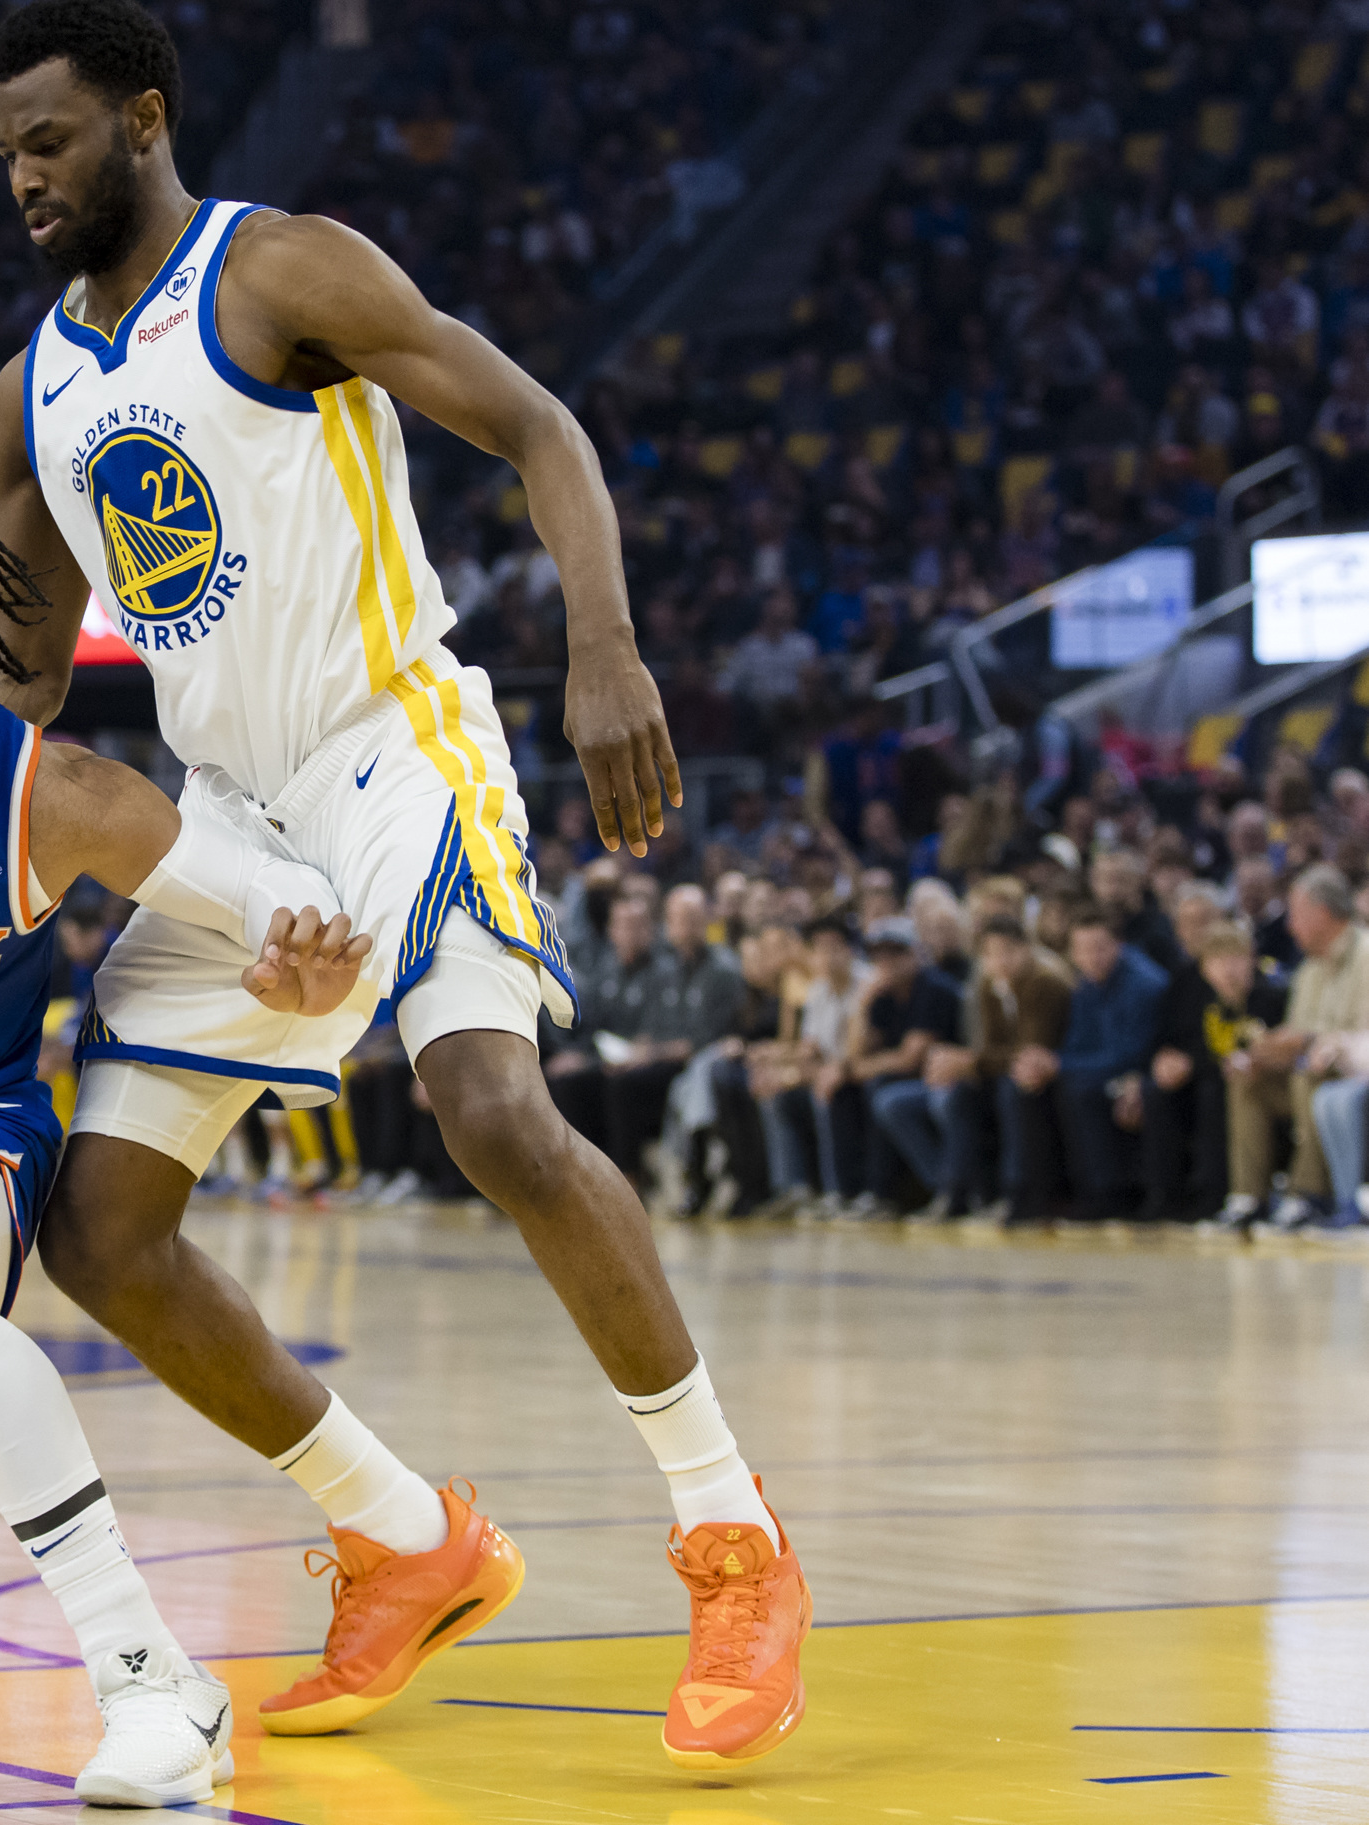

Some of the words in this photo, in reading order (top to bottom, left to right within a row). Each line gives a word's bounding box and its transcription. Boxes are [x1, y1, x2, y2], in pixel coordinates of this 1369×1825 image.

[173, 276, 188, 293] DM
[138, 309, 189, 344] Rakuten
[72, 408, 121, 493] GOLDEN
[129, 403, 186, 441] STATE
[141, 460, 196, 522] 22
[116, 551, 247, 651] WARRIORS
[726, 1528, 741, 1541] 22
